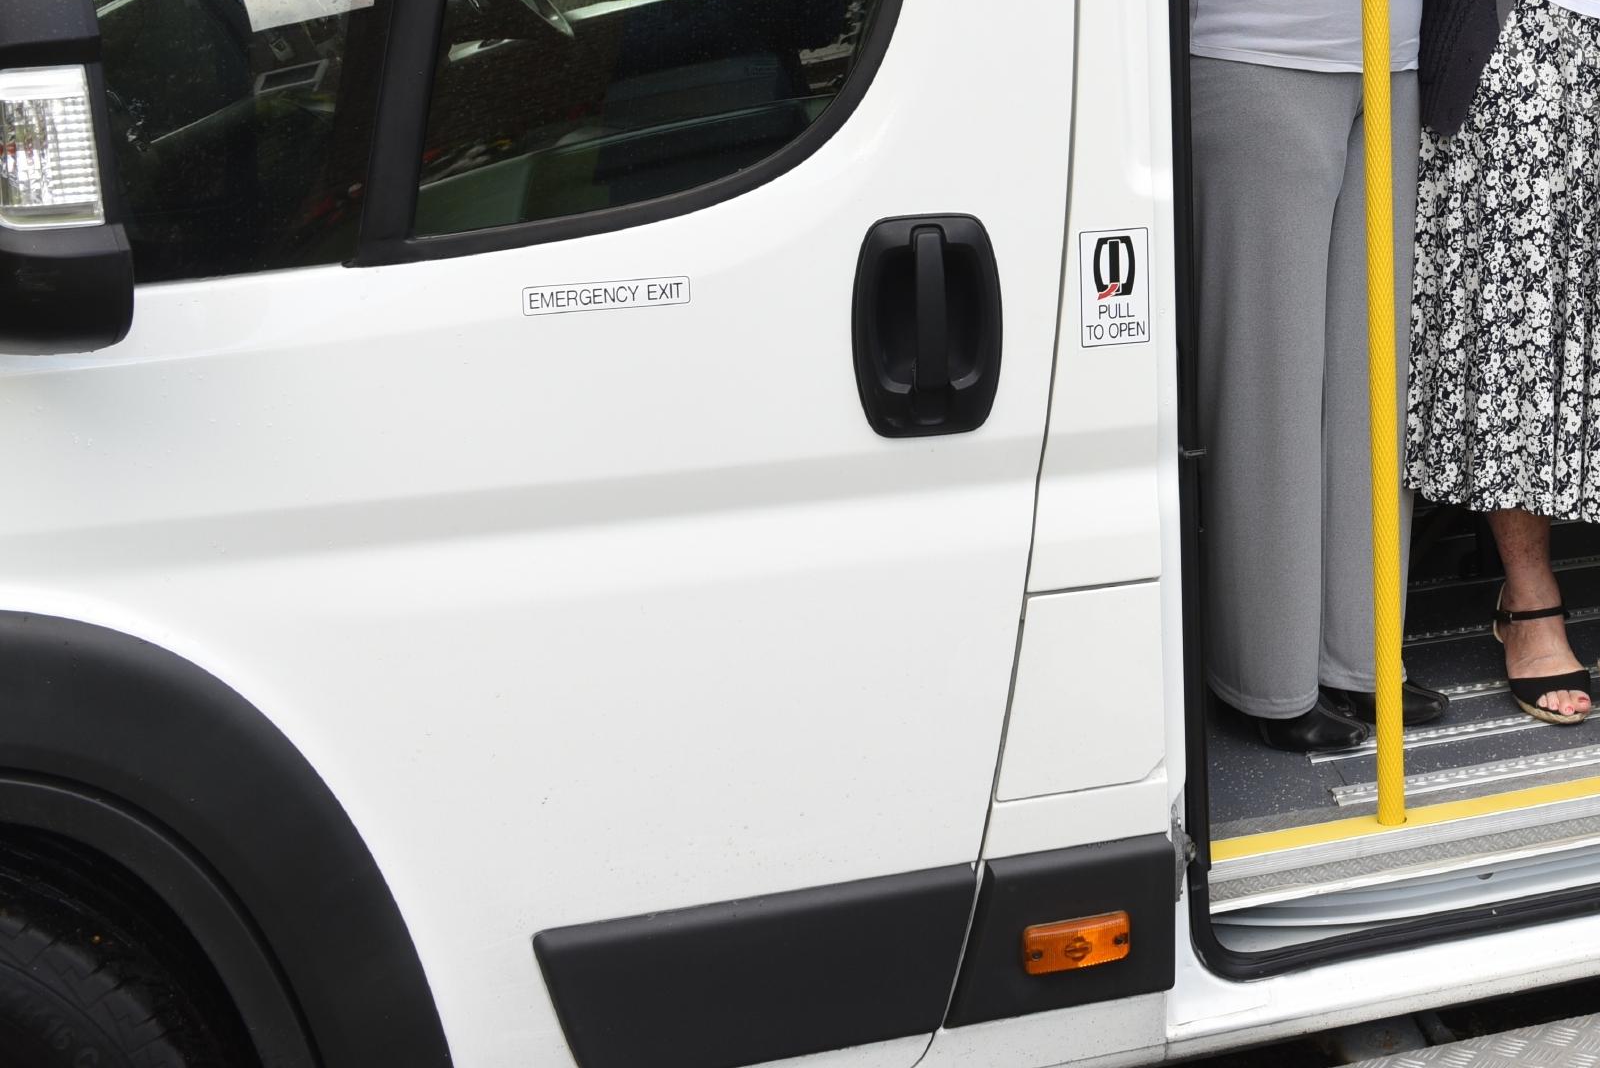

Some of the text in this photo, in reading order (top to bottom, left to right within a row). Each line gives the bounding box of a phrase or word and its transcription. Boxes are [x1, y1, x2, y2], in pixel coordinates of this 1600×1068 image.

[529, 282, 683, 310] EMERGENCY EXIT
[1098, 302, 1136, 320] PULL
[1086, 321, 1146, 341] TO OPEN
